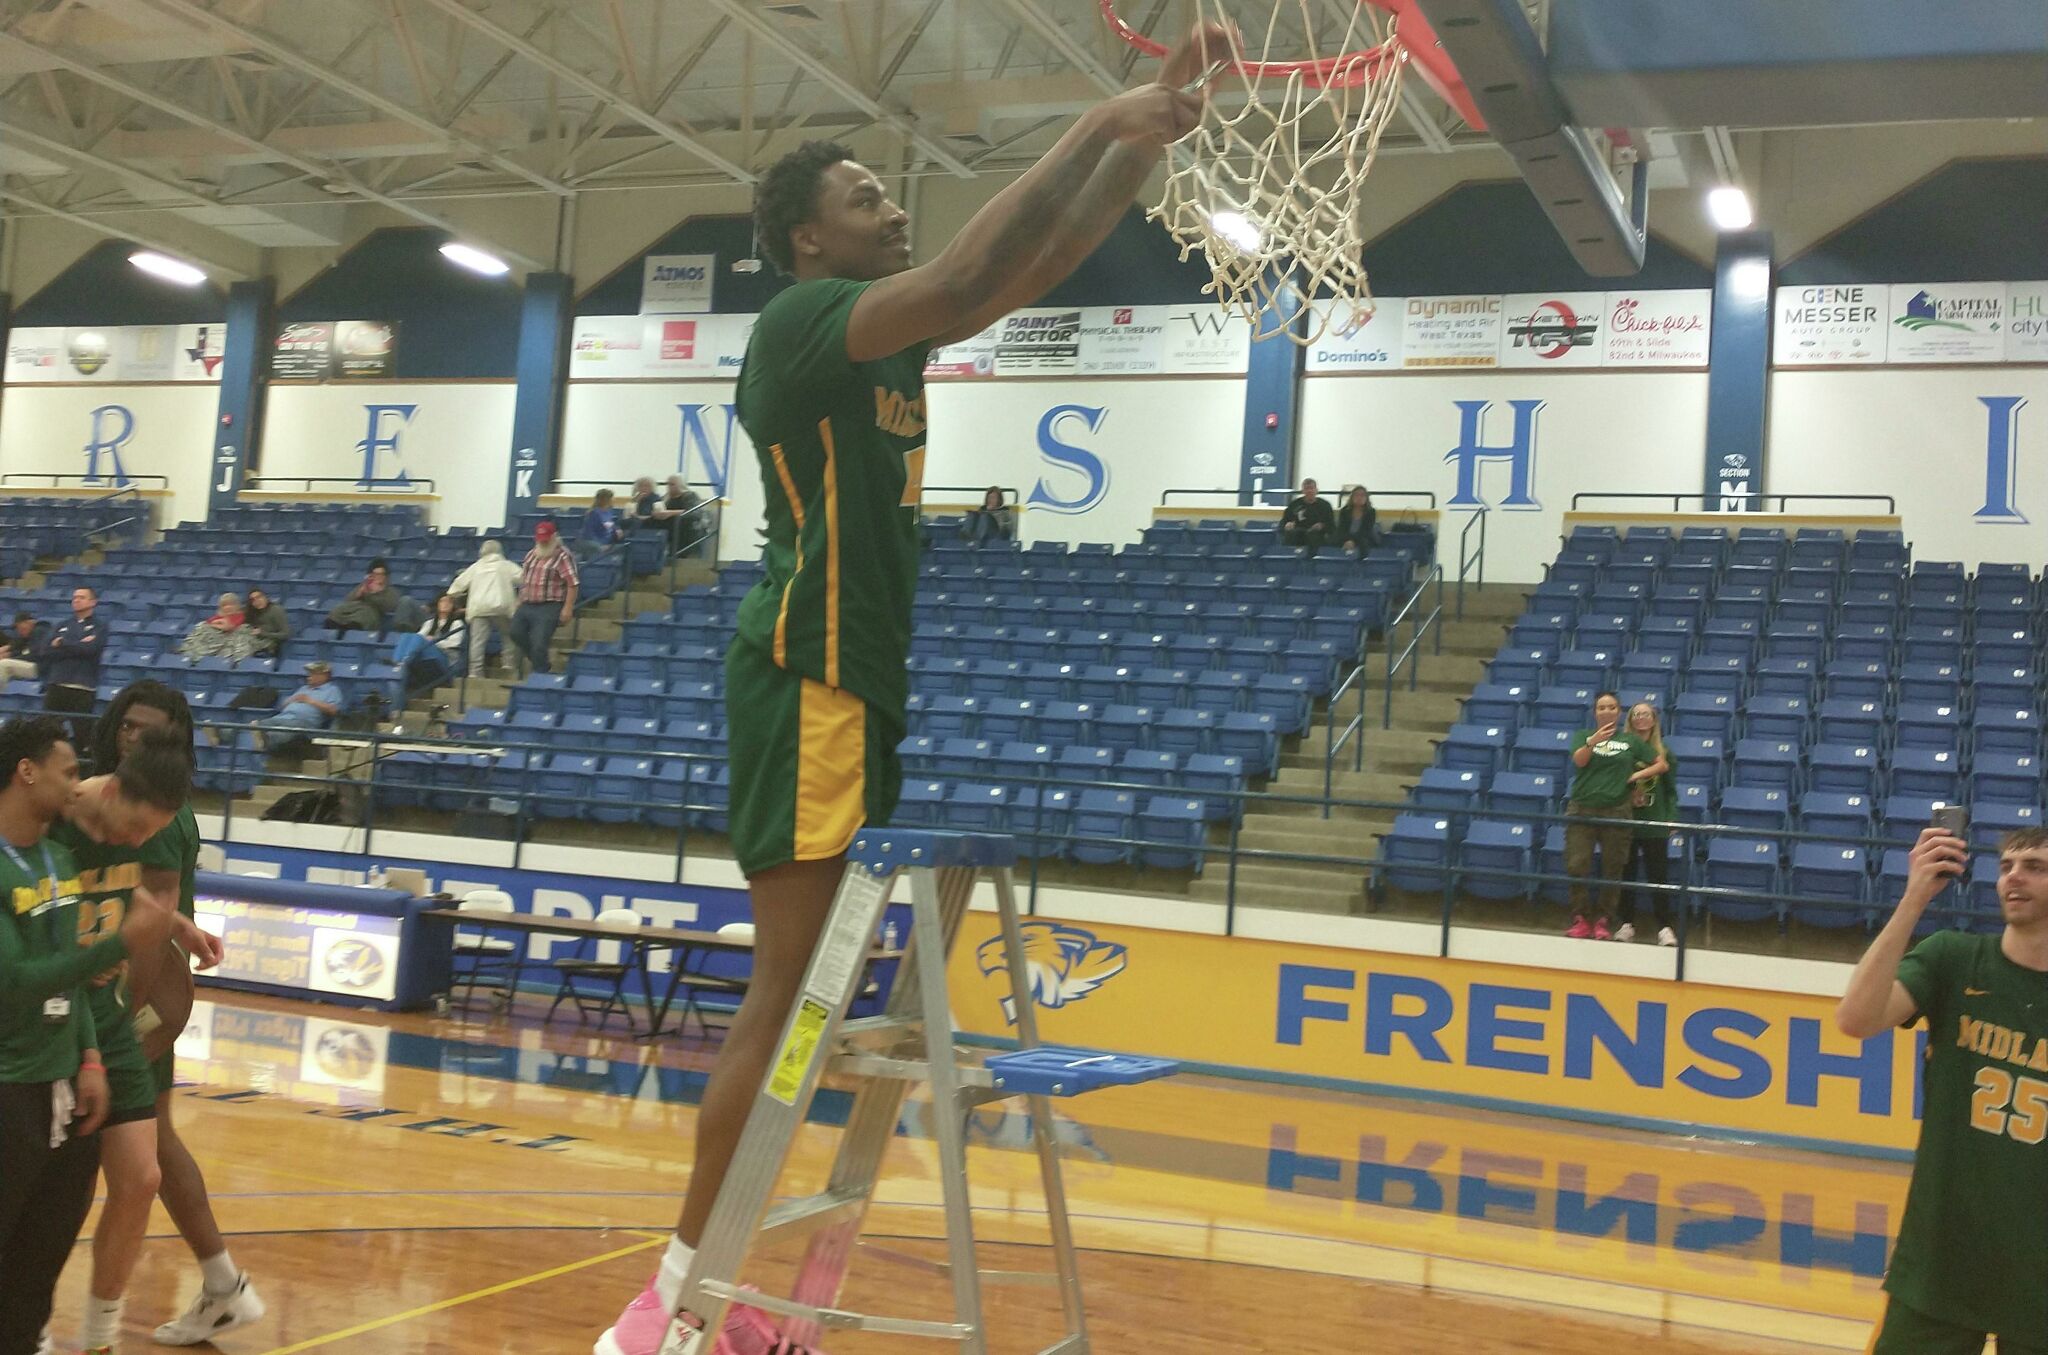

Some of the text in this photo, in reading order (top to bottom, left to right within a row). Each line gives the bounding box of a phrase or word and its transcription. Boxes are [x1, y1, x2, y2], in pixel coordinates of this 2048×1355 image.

[651, 265, 705, 282] ATMOS
[1802, 287, 1864, 303] GENE
[1937, 297, 2001, 311] CAPITAL
[1408, 296, 1500, 319] Dynamic
[1785, 306, 1878, 324] MESSER
[1006, 316, 1058, 330] PAINT
[1189, 311, 1234, 336] W
[1408, 318, 1497, 330] Heating and Air
[1507, 314, 1600, 325] HOMETOWN
[2011, 319, 2043, 337] city
[1002, 329, 1073, 343] DOCTOR
[1420, 330, 1483, 340] West Texas
[1507, 325, 1599, 348] TIRE
[1791, 326, 1872, 335] AUTO GROUP
[1185, 338, 1232, 349] WEST
[1317, 348, 1390, 363] Domino's
[84, 404, 141, 488] R
[355, 403, 421, 492] E
[676, 403, 742, 497] N
[1025, 404, 1112, 515] S
[1443, 399, 1549, 512] H
[1972, 396, 2031, 524] I
[216, 466, 233, 492] J
[515, 469, 534, 498] K
[1252, 477, 1269, 507] L
[1719, 480, 1748, 512] M
[527, 888, 699, 974] PIT
[1970, 1065, 2048, 1146] 25
